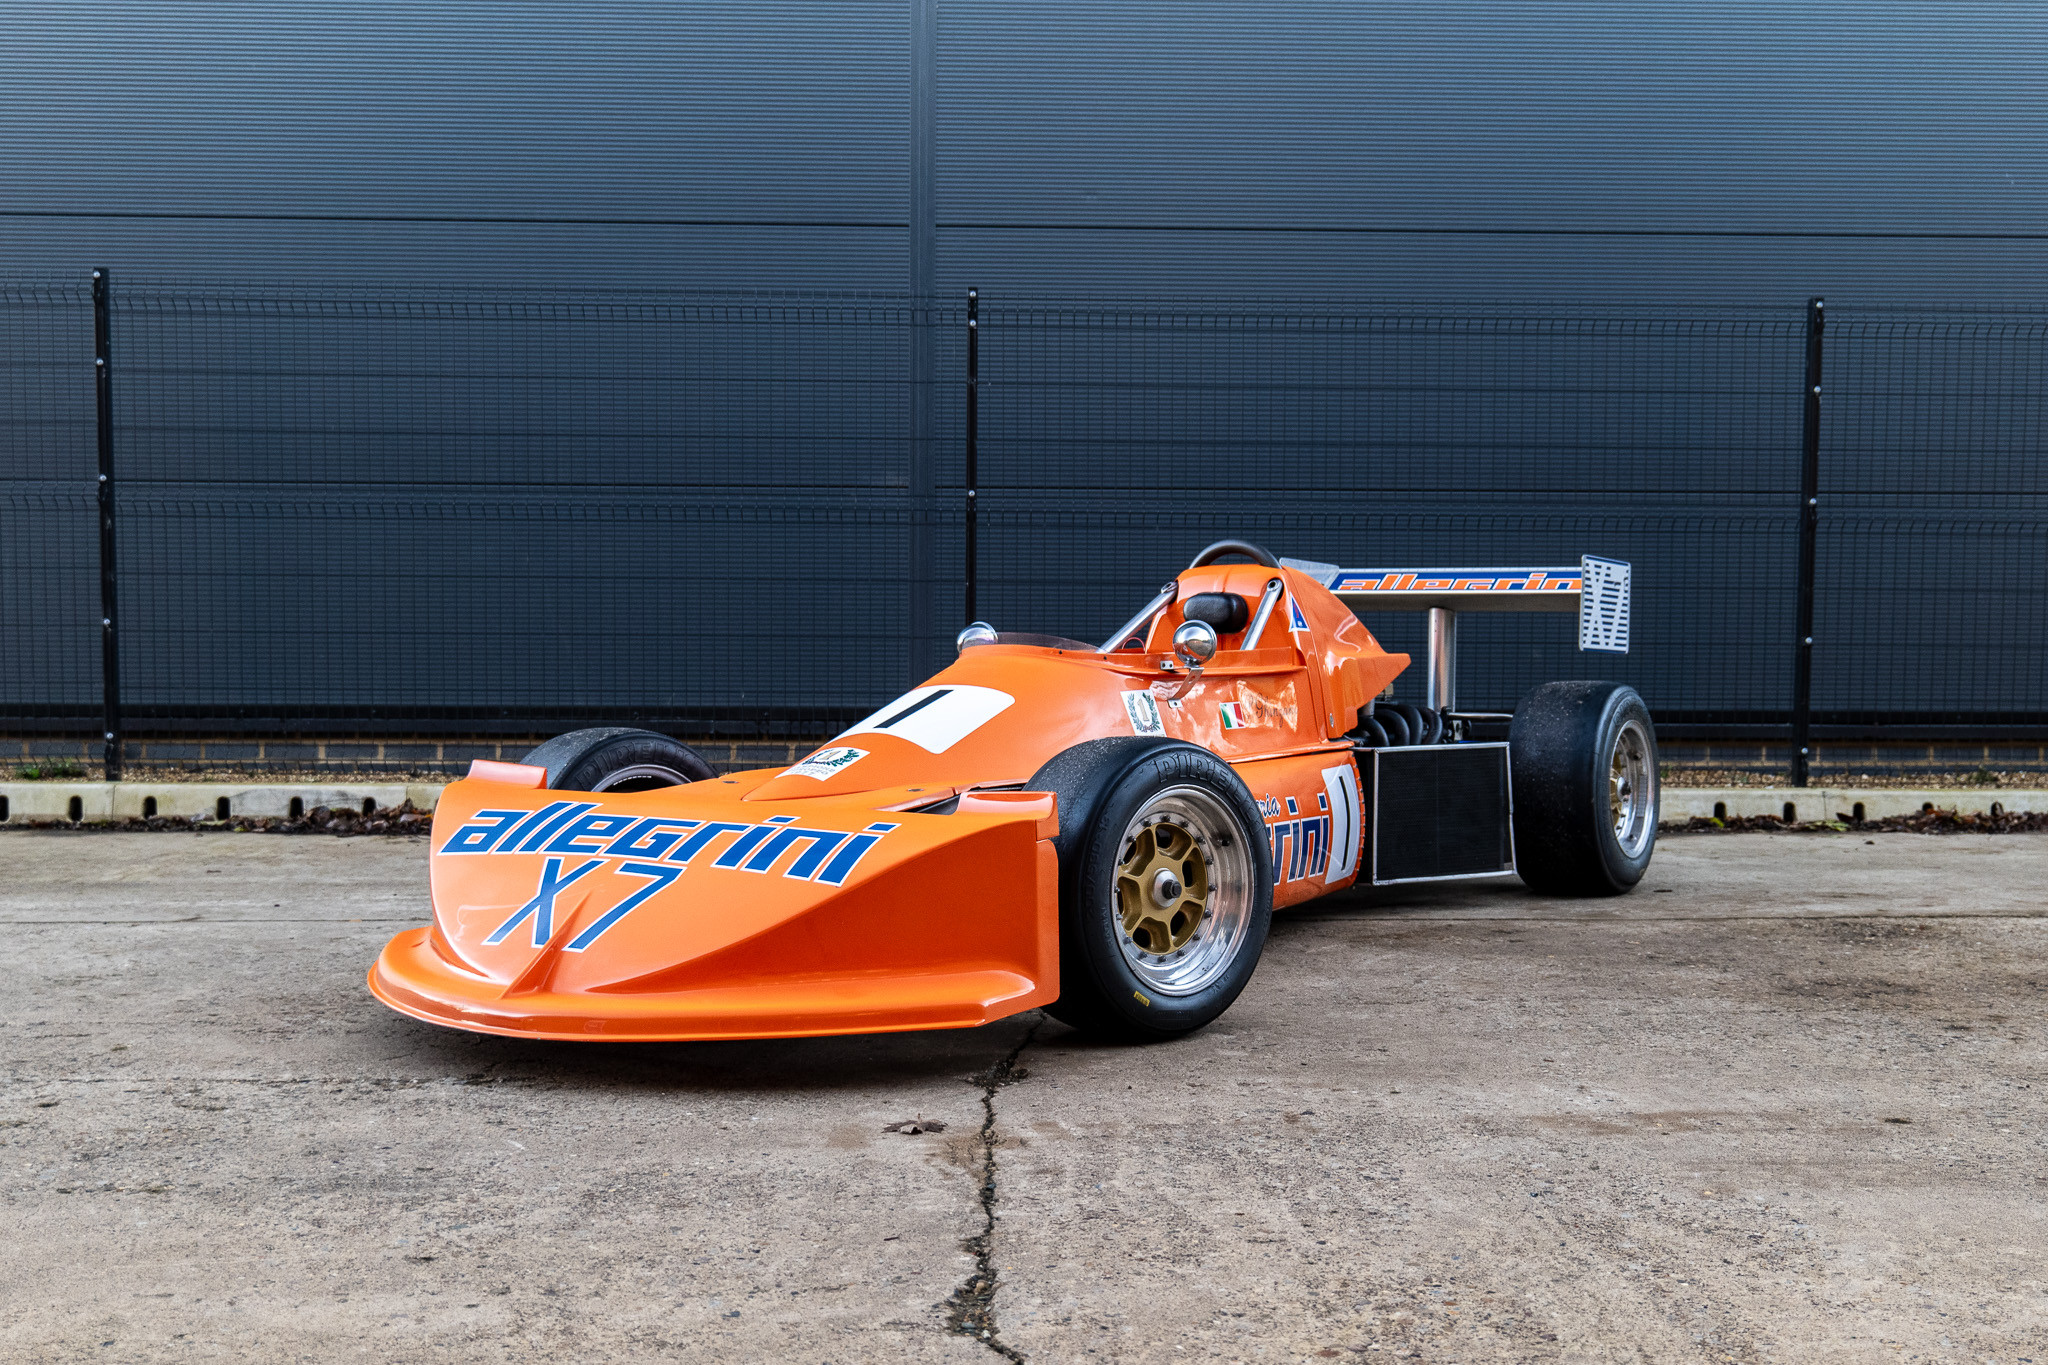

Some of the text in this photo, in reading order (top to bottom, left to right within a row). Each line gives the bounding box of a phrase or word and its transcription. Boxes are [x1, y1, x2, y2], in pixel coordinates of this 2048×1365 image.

[873, 690, 954, 728] 1
[1153, 752, 1264, 836] PIRELLI
[437, 800, 901, 887] allegrini
